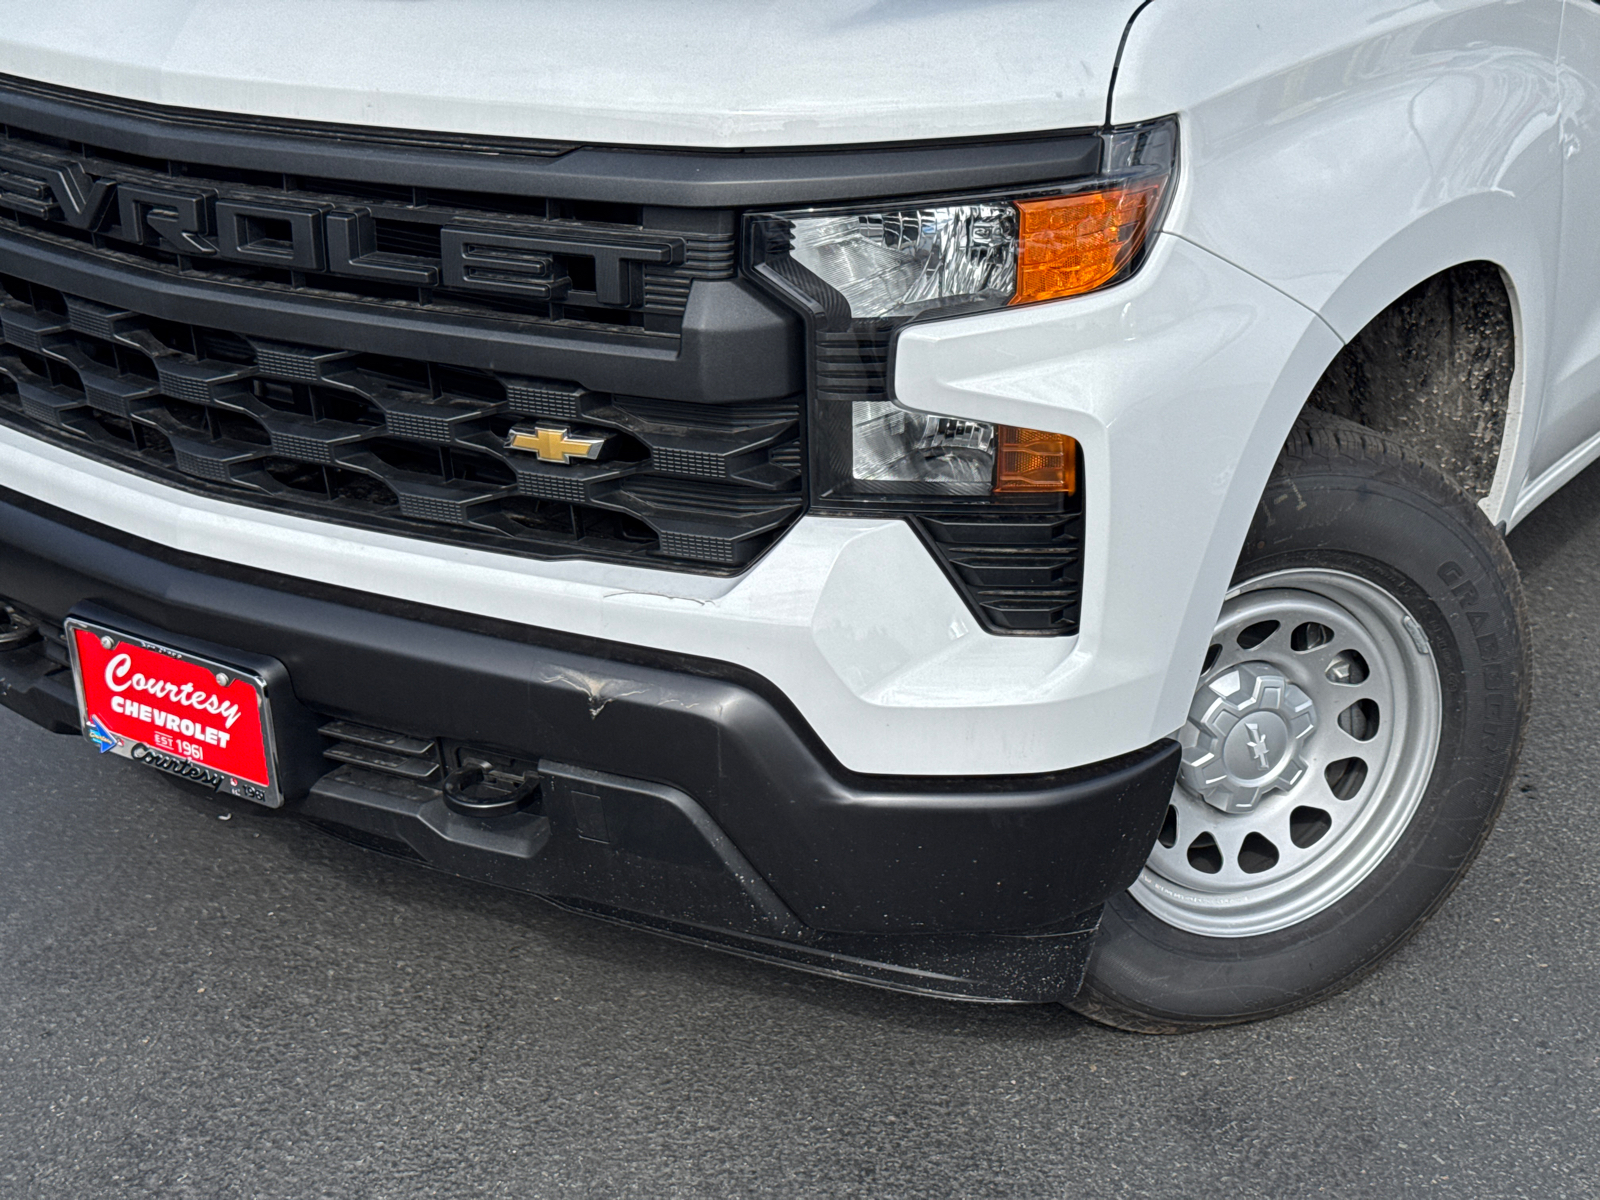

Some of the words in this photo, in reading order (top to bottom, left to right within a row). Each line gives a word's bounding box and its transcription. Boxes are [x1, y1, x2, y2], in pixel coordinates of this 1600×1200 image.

[1437, 560, 1503, 753] GRABBER
[104, 653, 242, 729] Courtesy
[111, 695, 230, 748] CHEVROLET
[154, 733, 174, 747] EST
[176, 738, 204, 760] 1961
[131, 742, 225, 793] Courtesy
